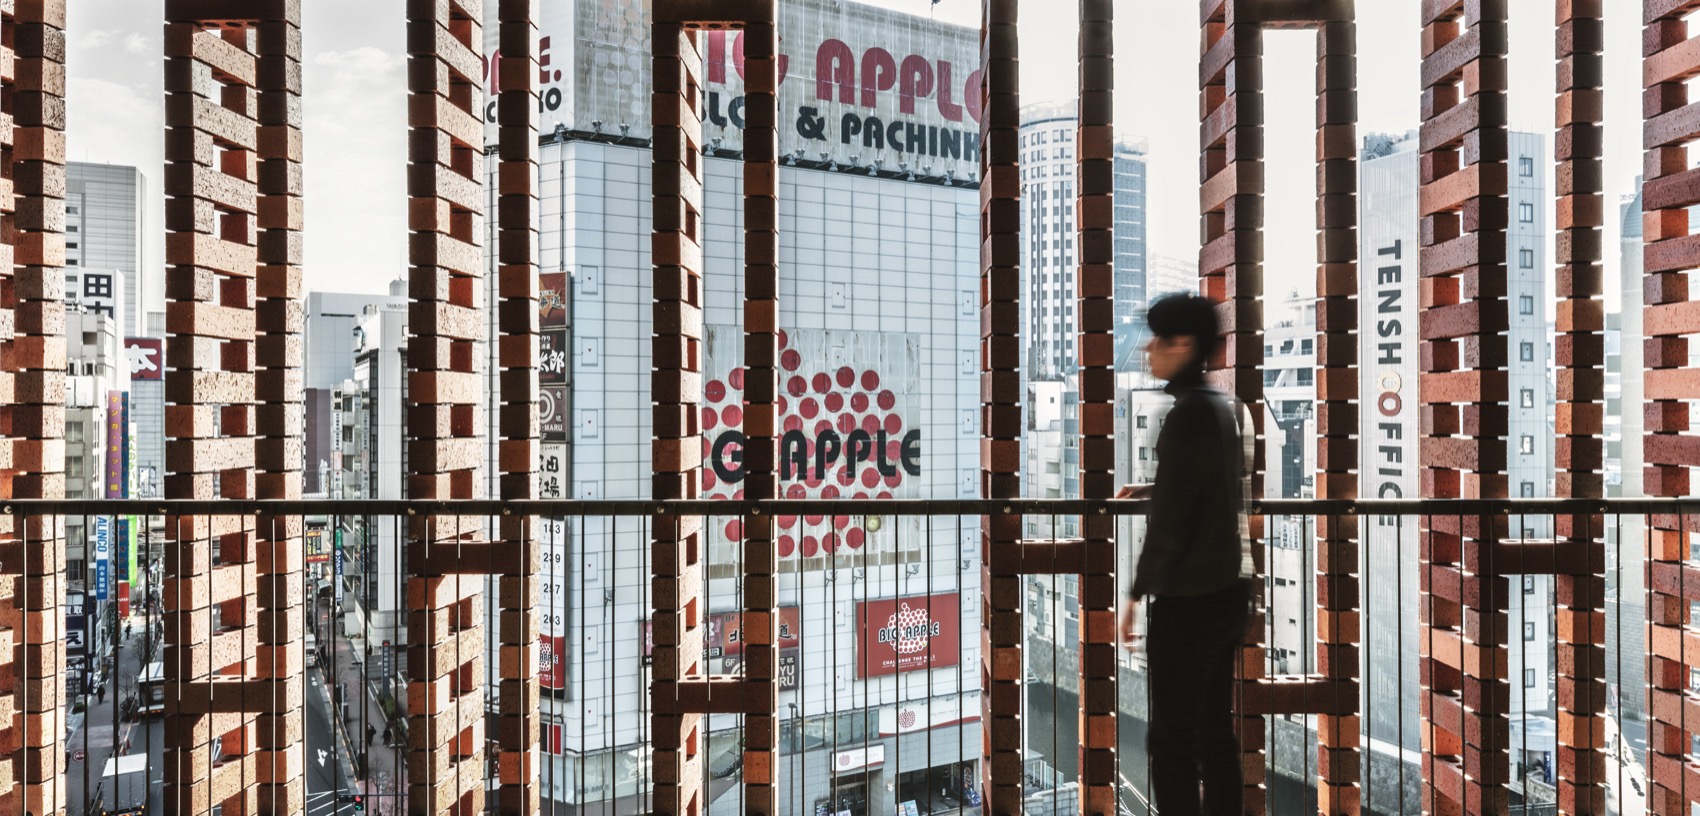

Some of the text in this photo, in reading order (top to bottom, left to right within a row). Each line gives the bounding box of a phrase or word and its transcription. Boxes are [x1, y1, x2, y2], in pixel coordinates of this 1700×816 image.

[796, 105, 827, 142] &
[780, 428, 921, 482] APPLE
[97, 516, 108, 553] ALINCO
[725, 659, 736, 667] 6F
[882, 657, 911, 666] CHALENGE
